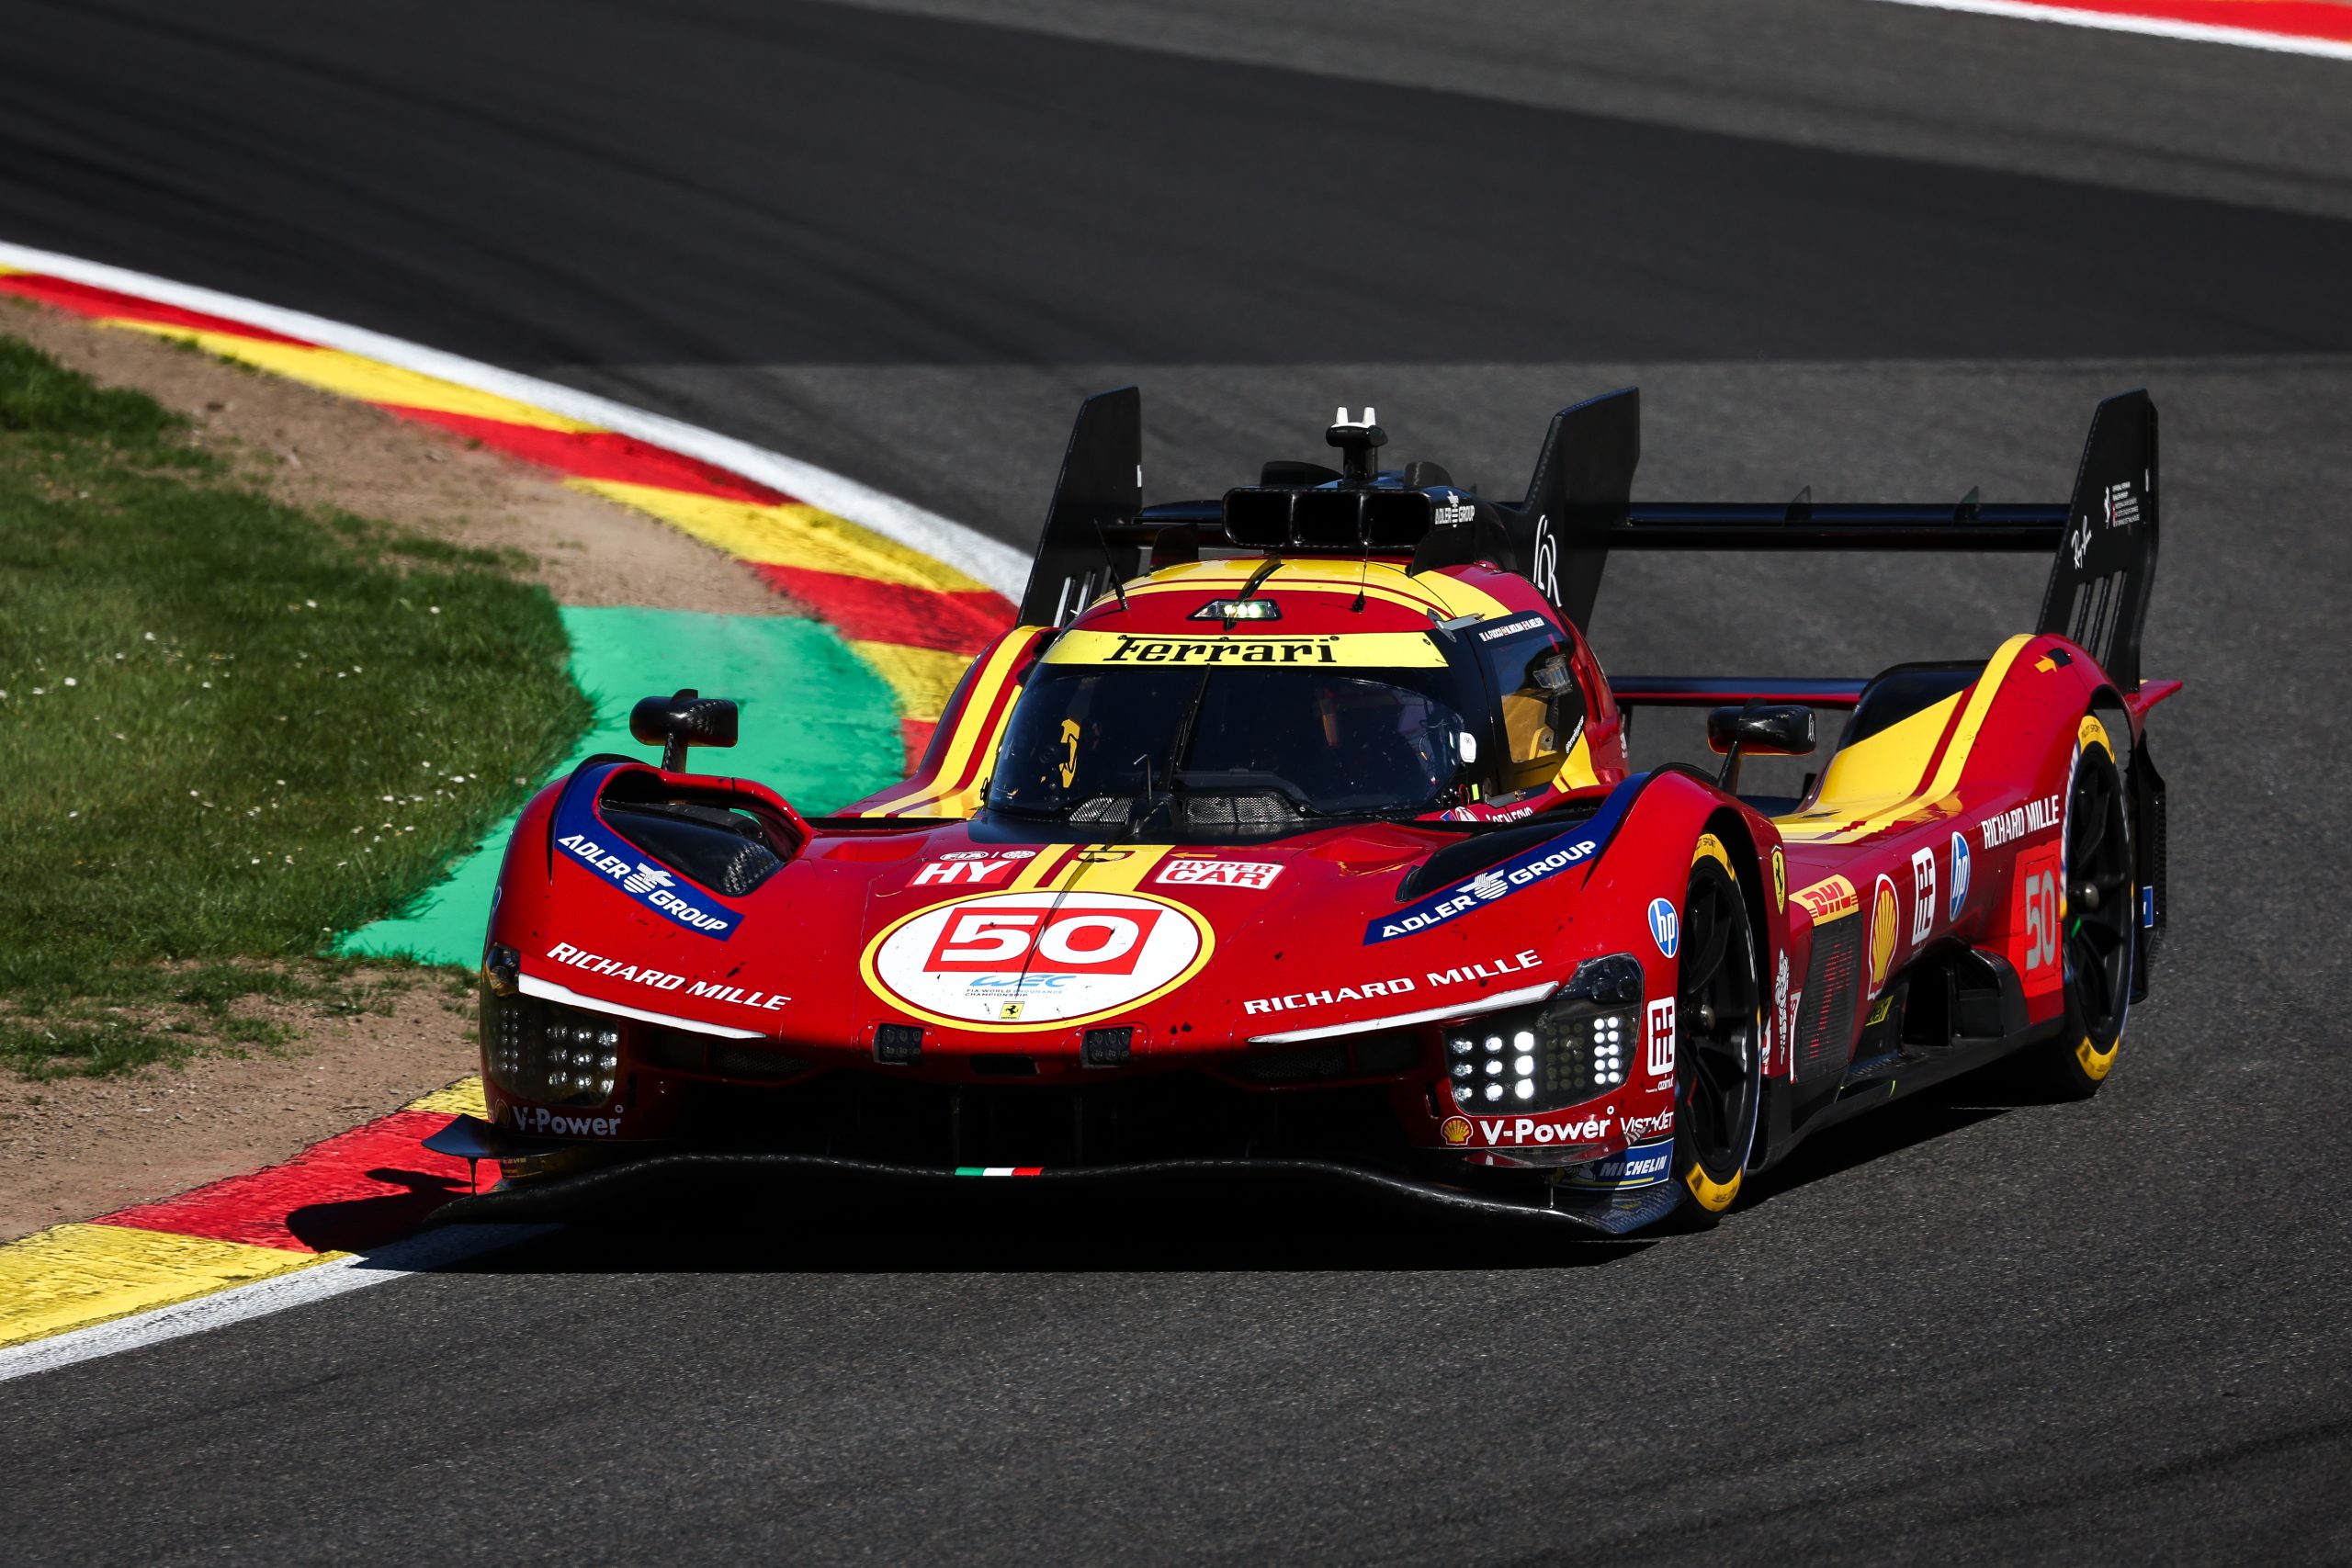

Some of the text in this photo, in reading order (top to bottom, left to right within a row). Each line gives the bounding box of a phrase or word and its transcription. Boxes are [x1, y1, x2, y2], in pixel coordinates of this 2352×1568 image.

[1435, 505, 1475, 525] ADLER GROUP
[1102, 634, 1339, 663] Ferrari
[1981, 795, 2059, 850] RICHARD MILLE
[557, 834, 729, 931] ADLER GROUP
[912, 860, 1012, 886] HY
[1165, 869, 1266, 886] CAR
[1174, 862, 1274, 874] HYPER
[1382, 840, 1597, 939] ADLER GROUP
[1653, 899, 1676, 957] hp
[2025, 870, 2056, 971] 50
[940, 915, 1138, 964] 50
[547, 942, 792, 1011] RICHARD MILLE
[969, 974, 1077, 987] WEC
[1243, 949, 1544, 1016] RICHARD MILLE
[514, 1106, 622, 1136] V-Power
[1480, 1118, 1611, 1145] V-Power
[1599, 1155, 1668, 1177] MICHELIN
